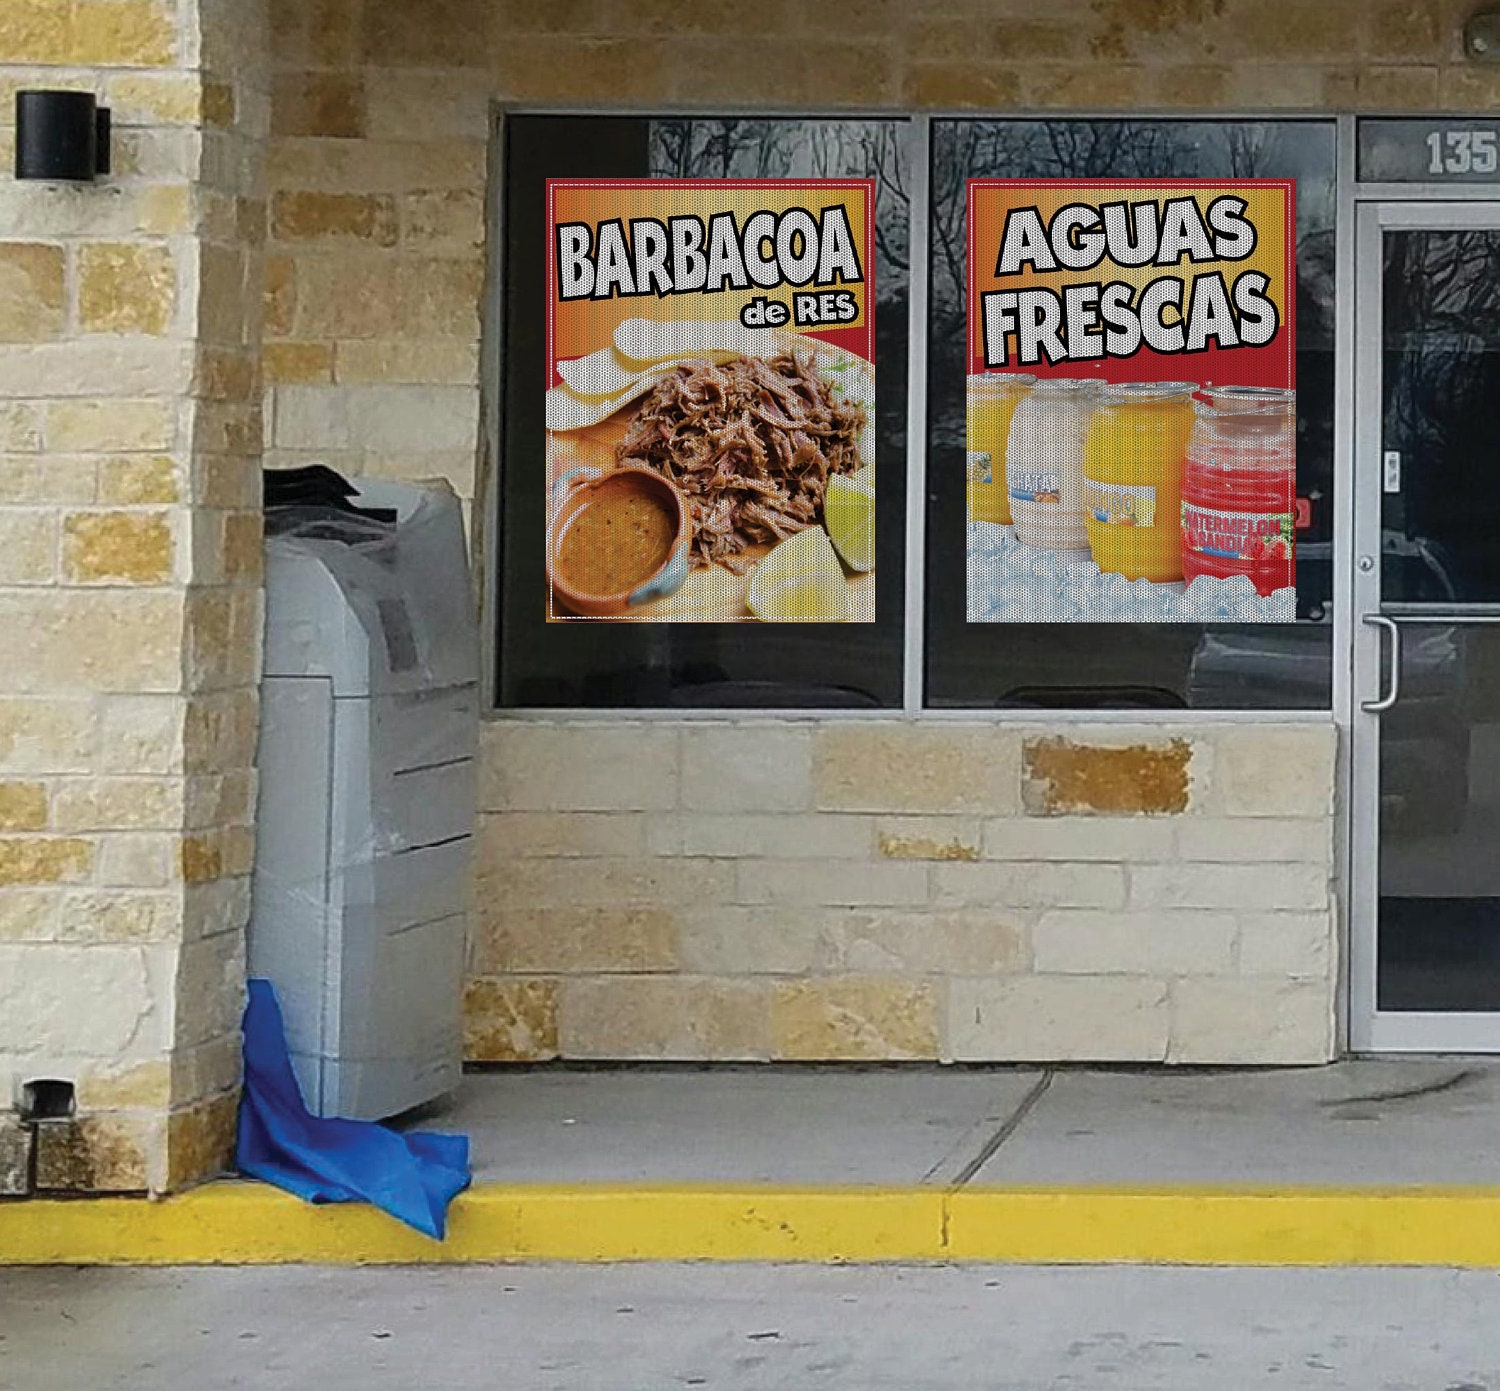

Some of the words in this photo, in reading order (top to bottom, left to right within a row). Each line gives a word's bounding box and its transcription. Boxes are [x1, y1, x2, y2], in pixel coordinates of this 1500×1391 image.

[556, 203, 864, 302] BARBACOA
[994, 195, 1258, 277] AGUAS
[740, 296, 789, 328] de
[793, 290, 860, 326] RES
[981, 270, 1280, 368] FRESCAS
[1184, 509, 1281, 537] WATERMELON
